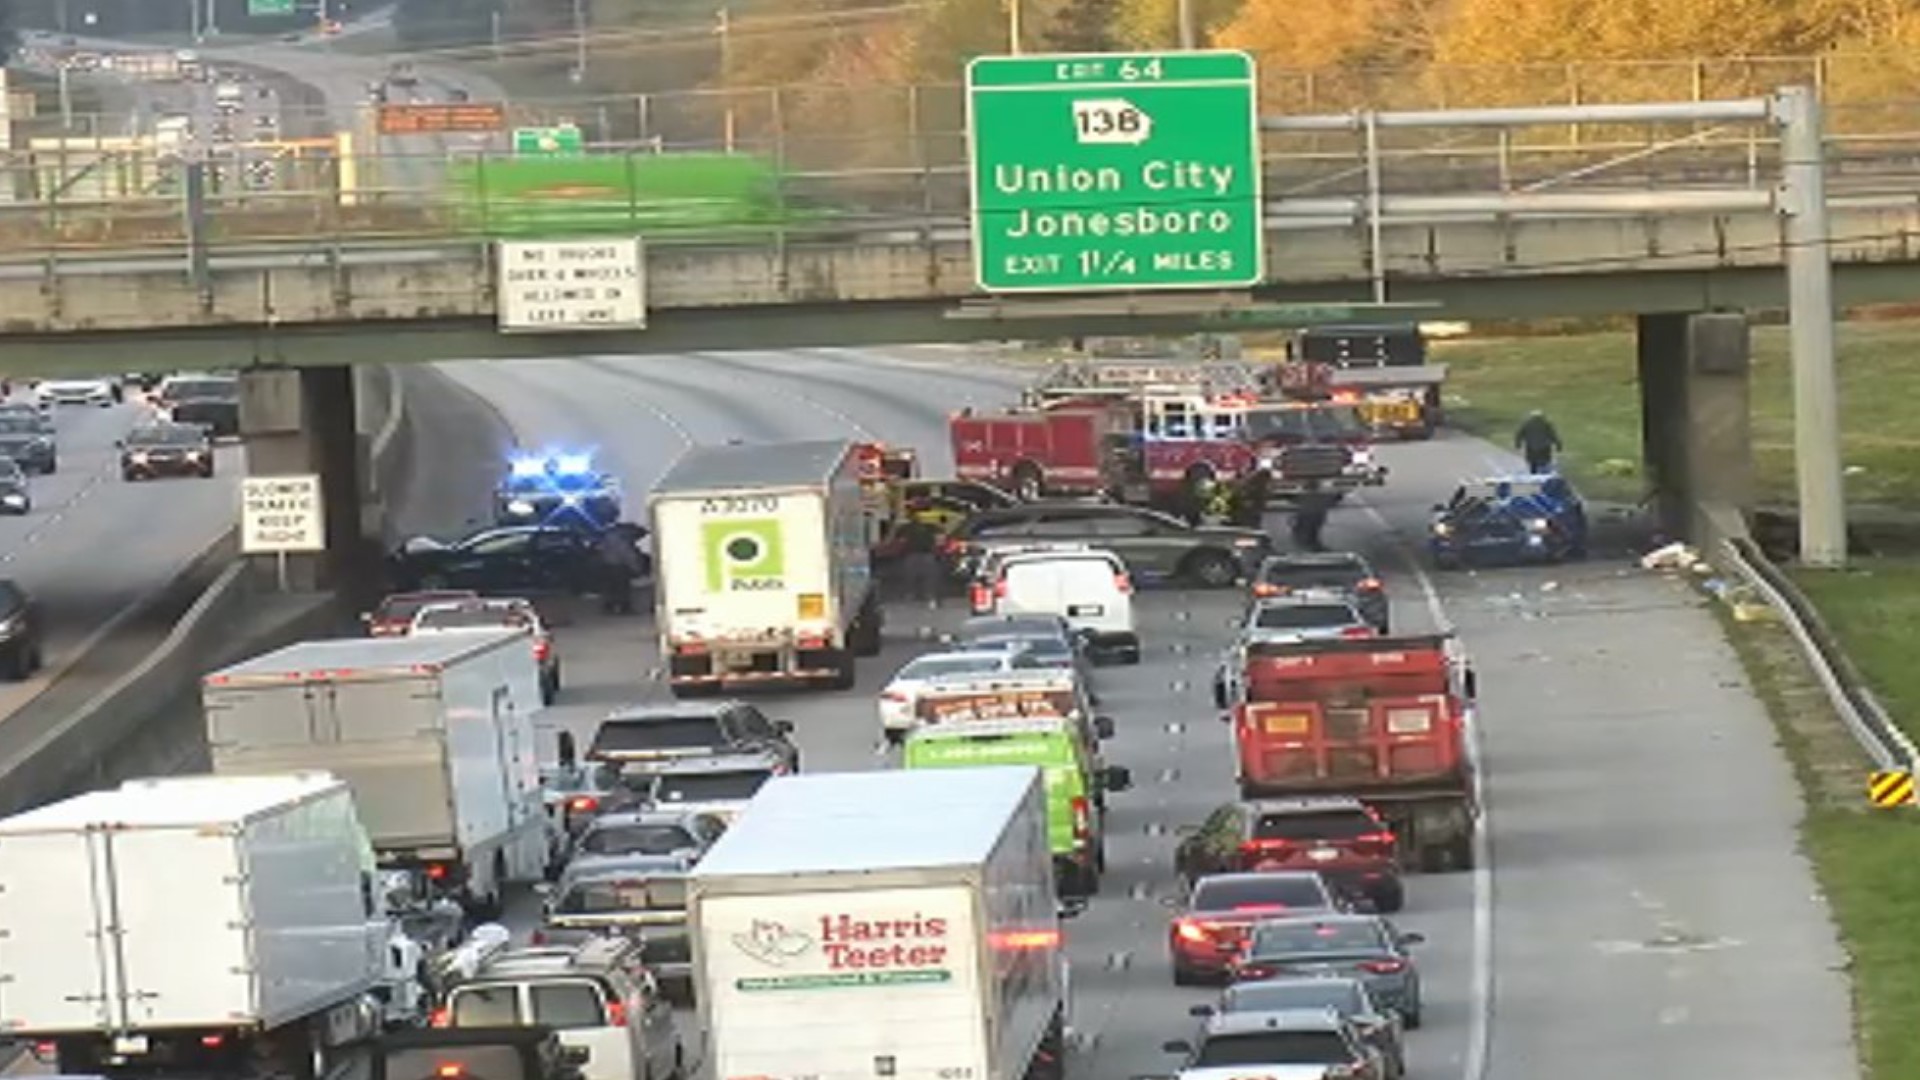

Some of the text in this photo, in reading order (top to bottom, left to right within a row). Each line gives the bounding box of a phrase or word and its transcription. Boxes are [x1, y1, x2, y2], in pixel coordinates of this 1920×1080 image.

[1118, 58, 1165, 80] 64
[995, 160, 1234, 196] Union City
[1006, 206, 1231, 237] Jonesboro
[1004, 254, 1061, 275] EXIT
[1153, 250, 1234, 271] MILES
[820, 912, 947, 942] Harris
[823, 943, 946, 969] Teeter
